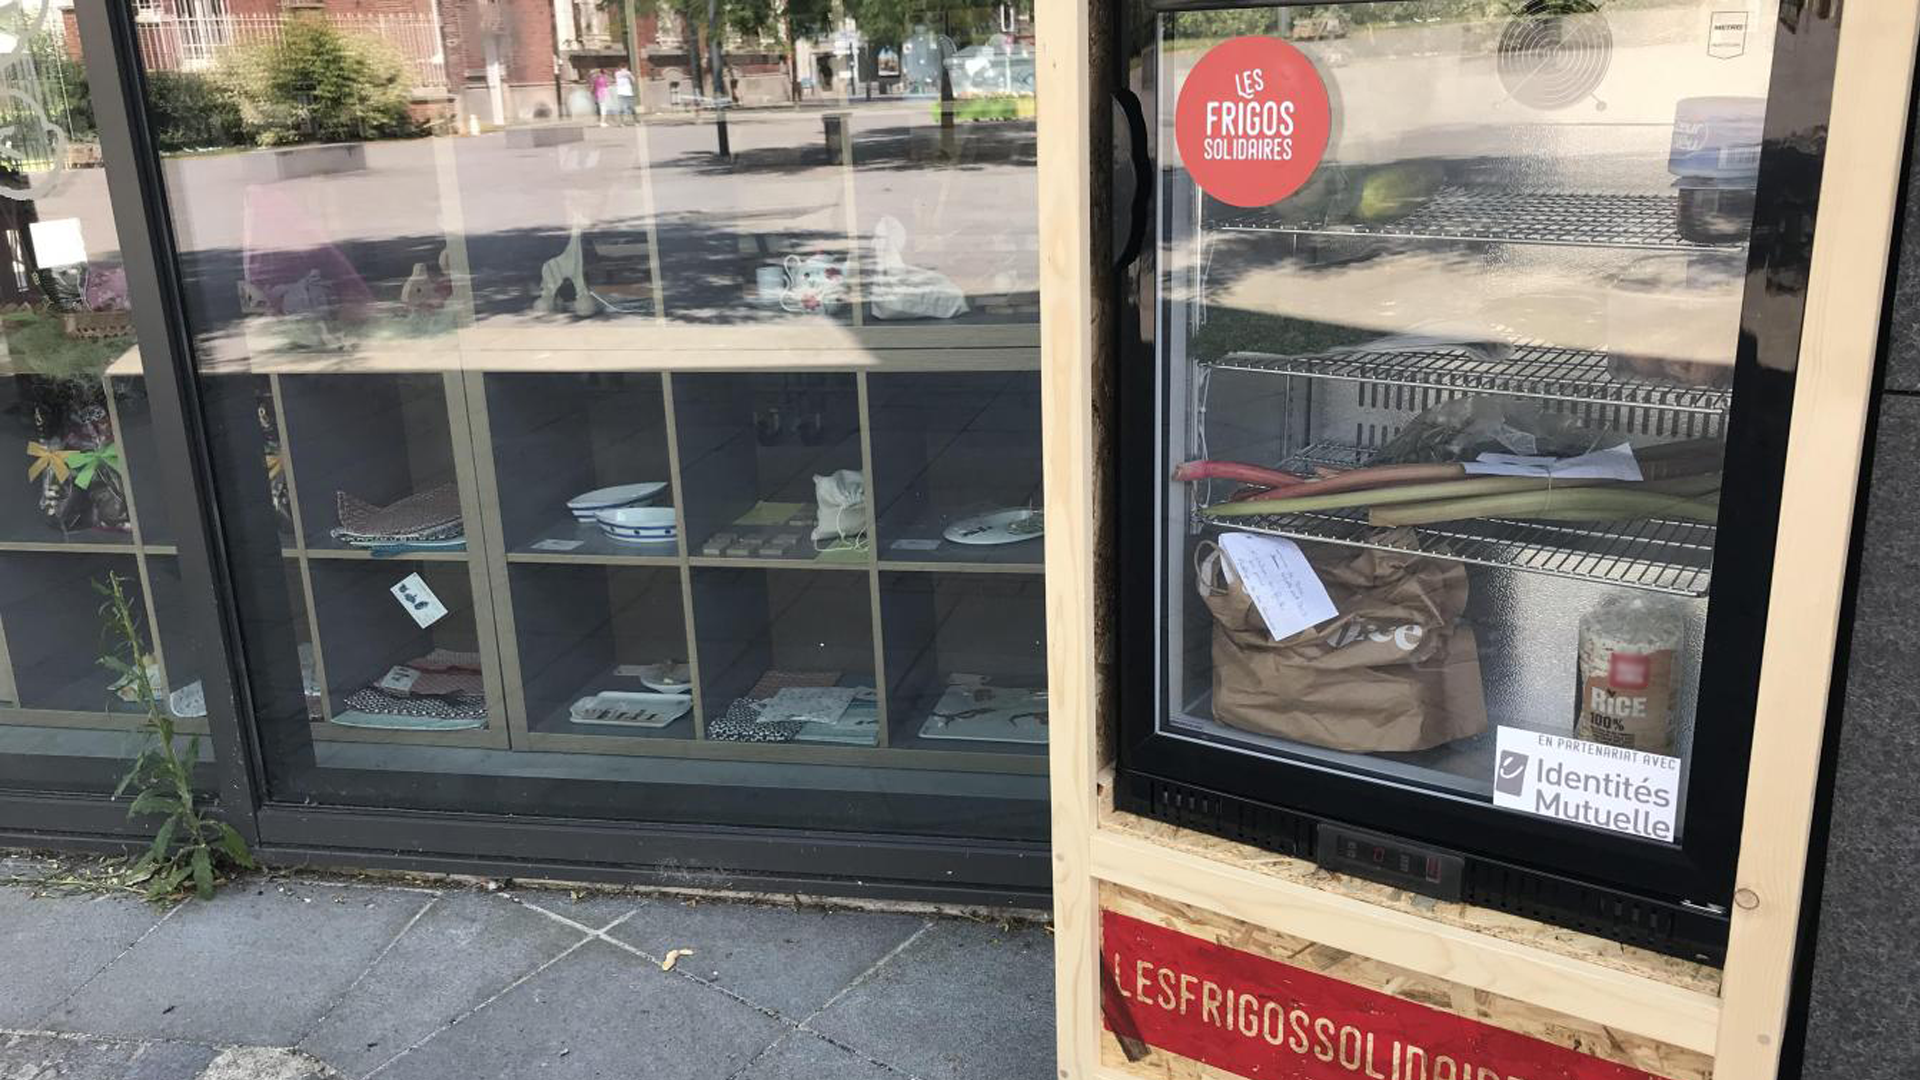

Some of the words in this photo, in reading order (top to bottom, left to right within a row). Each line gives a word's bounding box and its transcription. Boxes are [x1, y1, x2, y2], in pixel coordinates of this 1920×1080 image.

[1235, 69, 1264, 99] LES
[1206, 101, 1294, 137] FRIGOS
[1204, 138, 1292, 160] SOLIDAIRES
[1590, 712, 1625, 732] 100%
[1538, 735, 1553, 747] EN
[1557, 737, 1639, 763] PARTENARIAT
[1642, 754, 1676, 770] AVEC
[1537, 758, 1670, 808] Identités
[1535, 788, 1671, 839] Mutuelle
